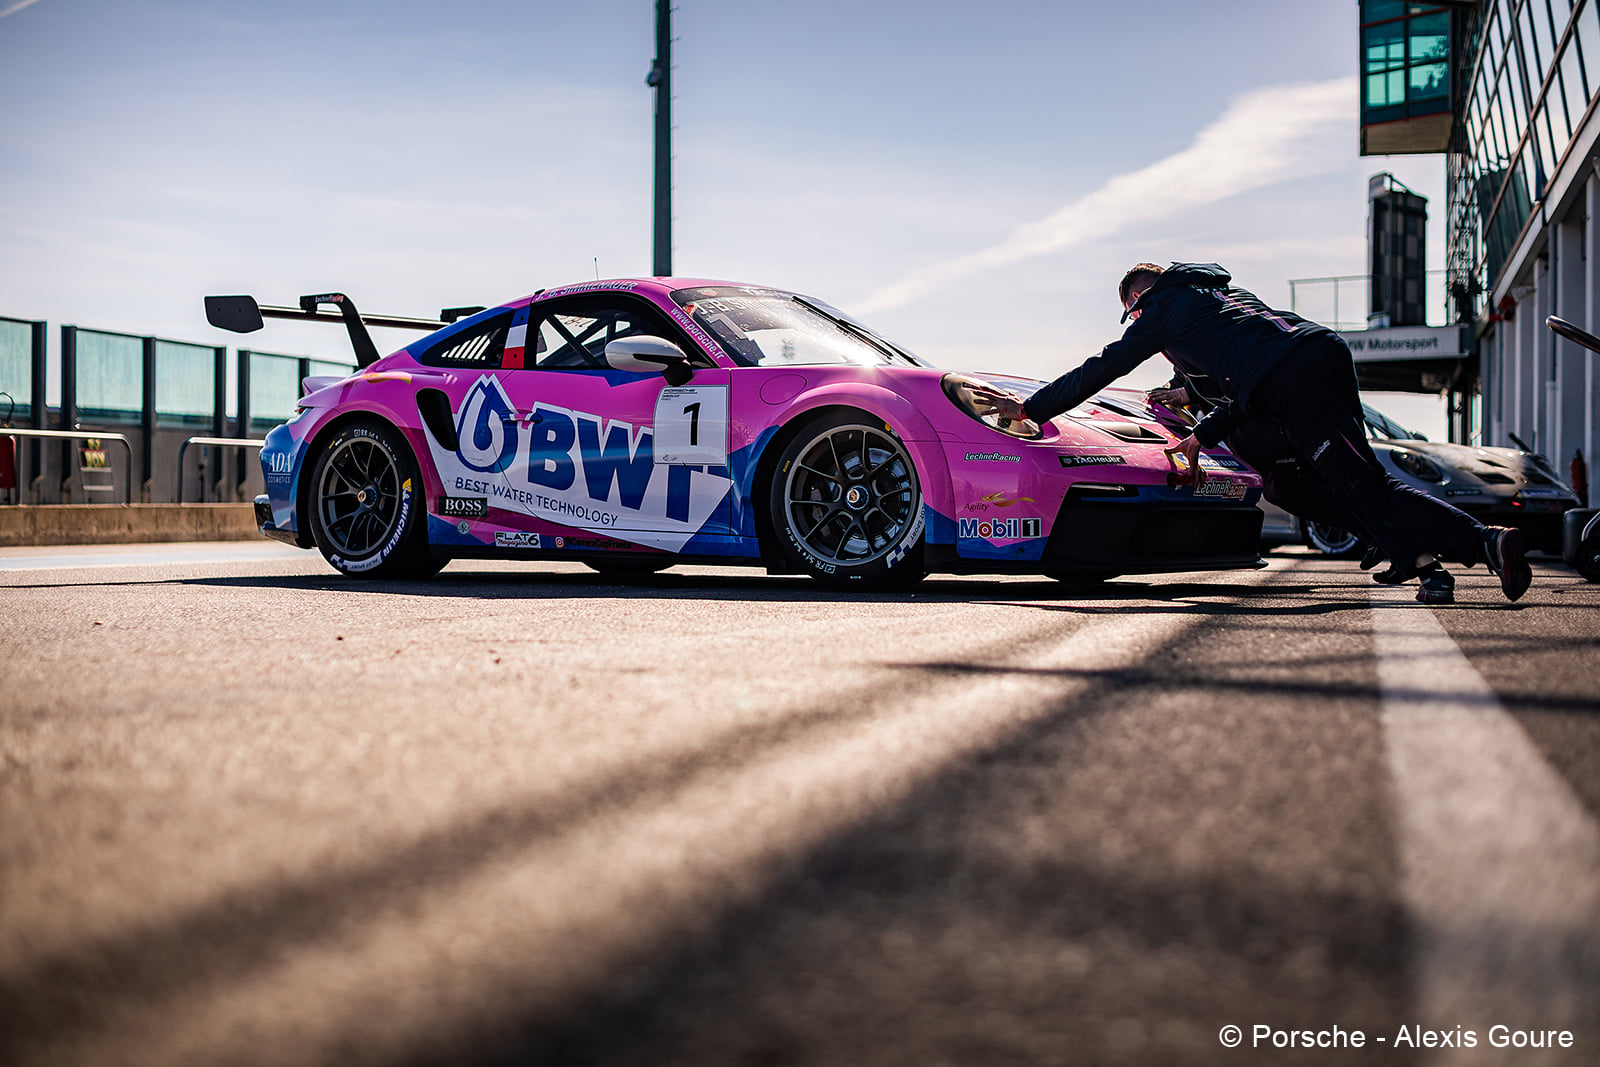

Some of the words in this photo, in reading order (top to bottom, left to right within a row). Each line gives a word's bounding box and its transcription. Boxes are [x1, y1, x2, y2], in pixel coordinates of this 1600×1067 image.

[670, 307, 725, 360] www.porsche.fr
[1368, 338, 1438, 352] Motorsport
[683, 402, 701, 446] 1
[268, 452, 291, 472] ADA
[528, 407, 703, 523] BWT
[965, 452, 1021, 463] LechneRacing
[267, 476, 291, 484] COSMETICS
[445, 499, 482, 511] BOSS
[455, 477, 490, 494] BEST
[492, 484, 533, 505] WATER
[536, 495, 618, 527] TECHNOLOGY
[964, 503, 989, 512] Agility
[383, 502, 409, 557] MICHELIN
[959, 518, 1019, 538] Mobil
